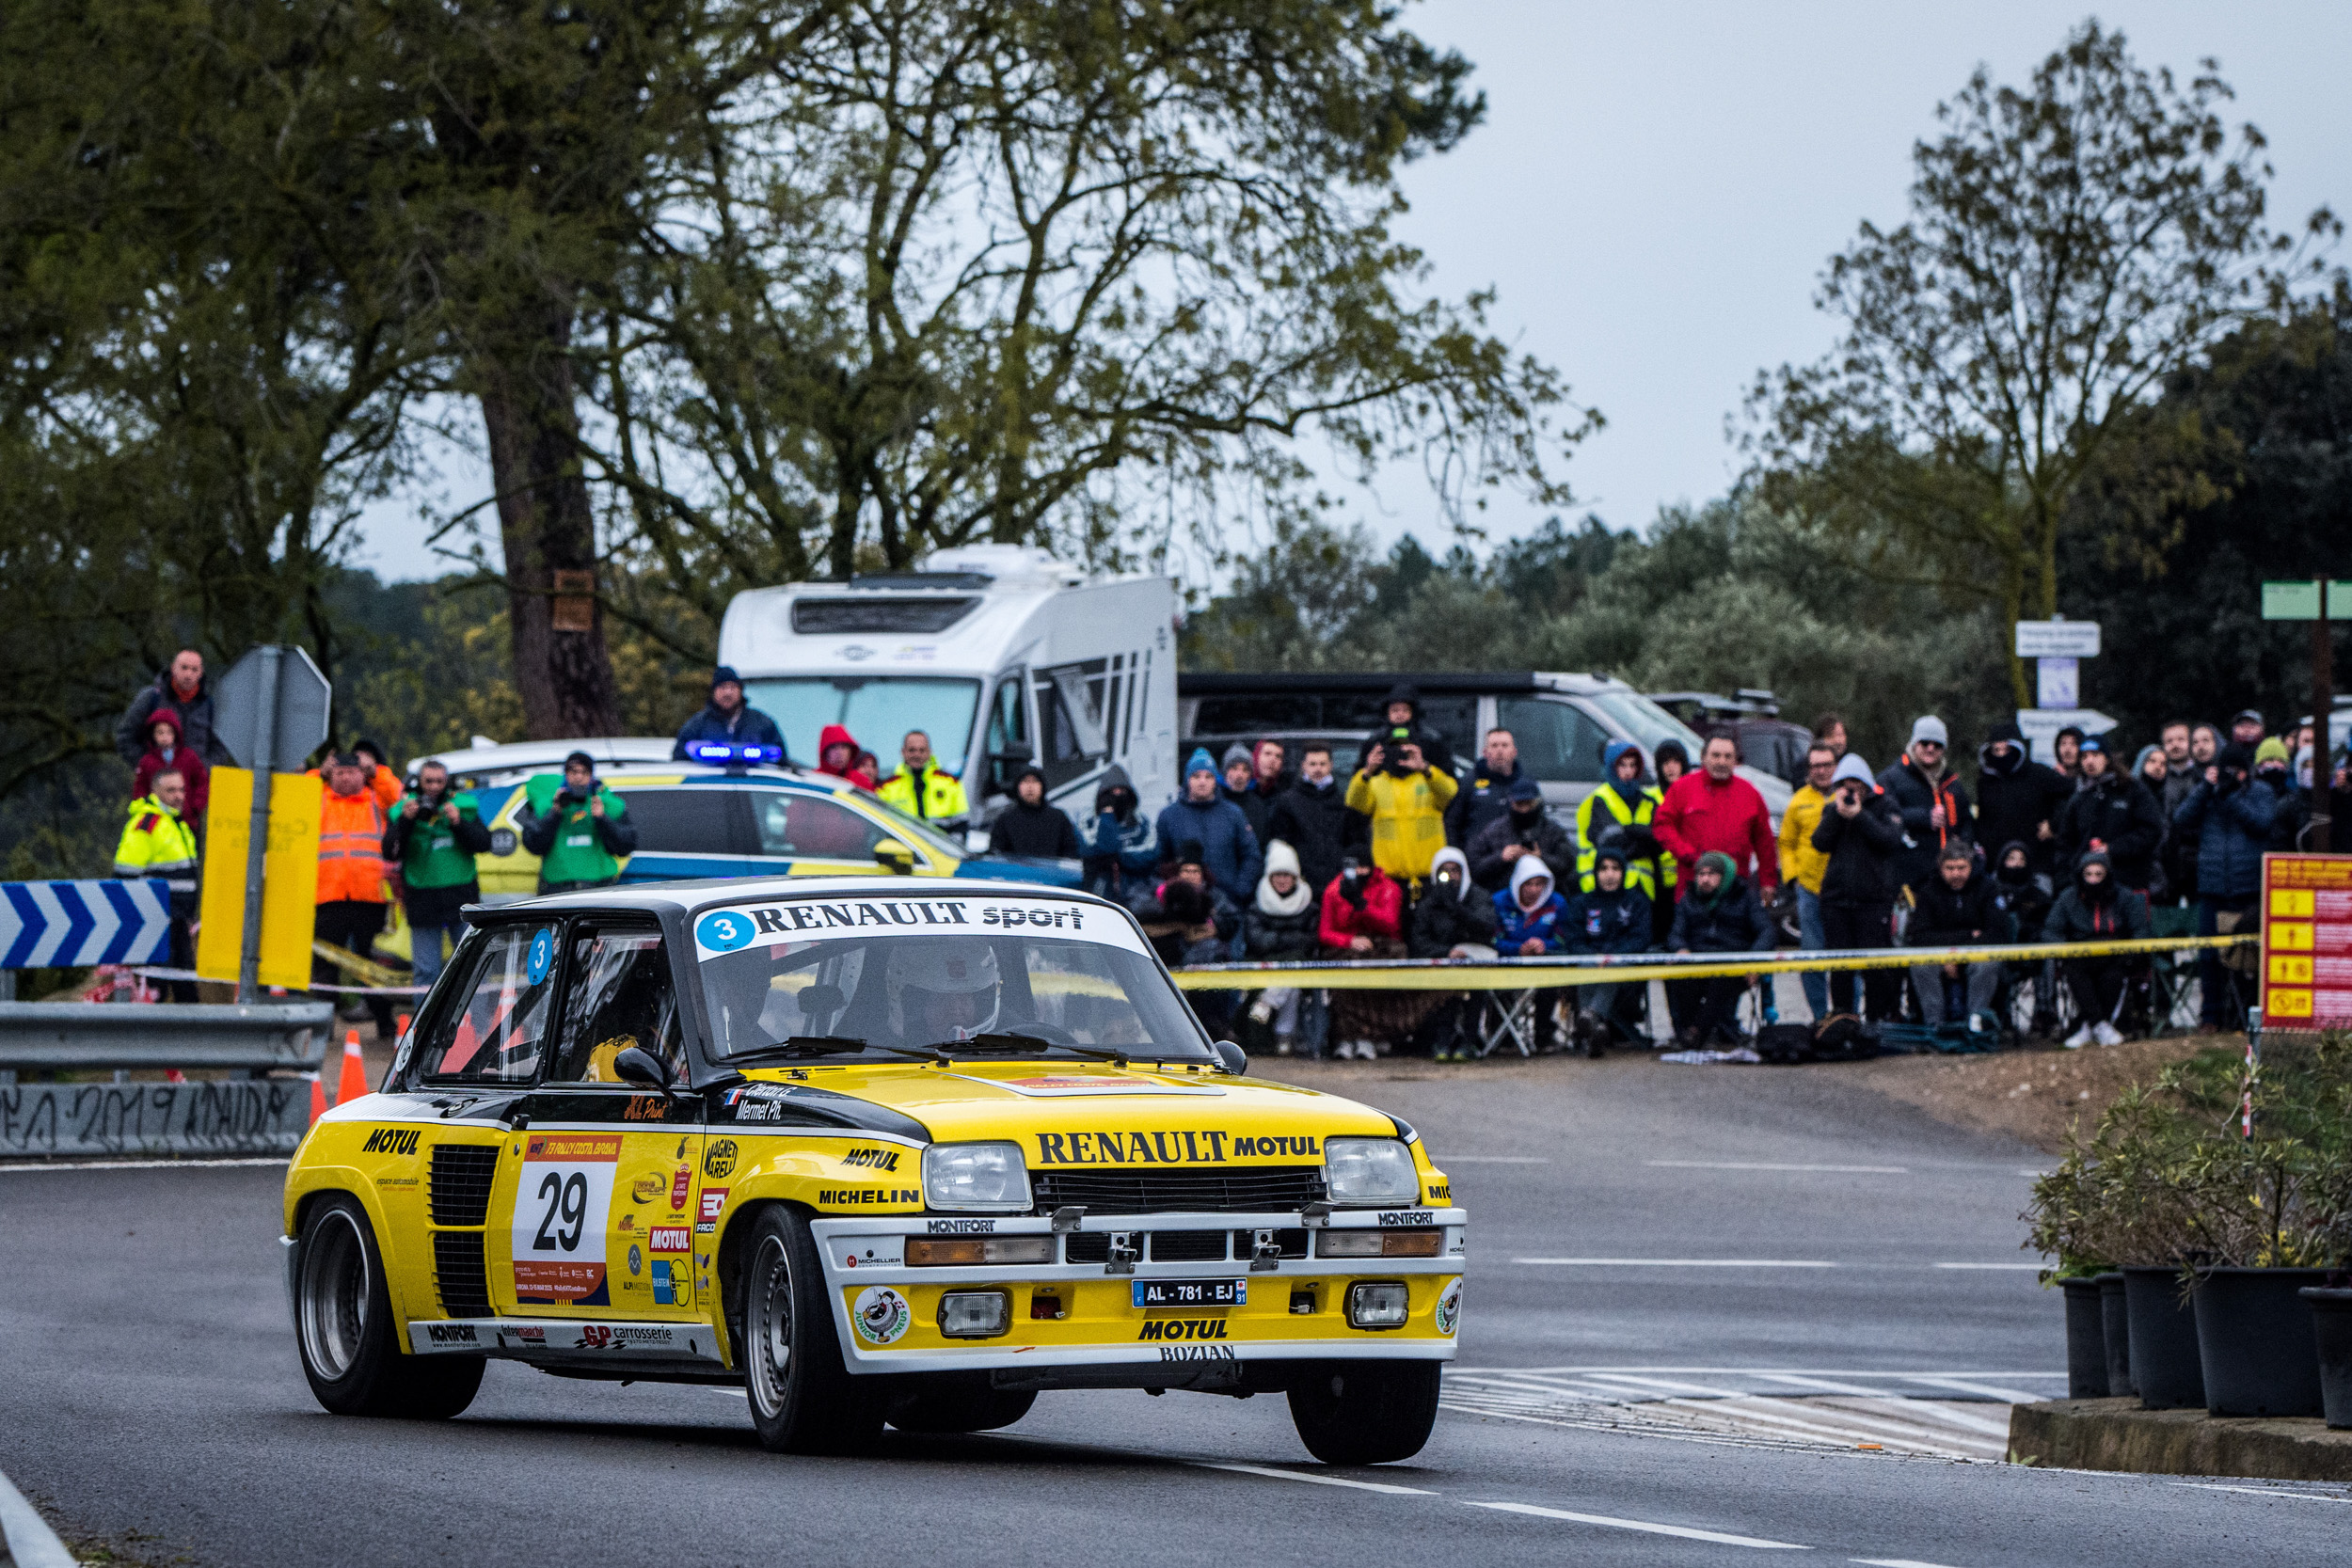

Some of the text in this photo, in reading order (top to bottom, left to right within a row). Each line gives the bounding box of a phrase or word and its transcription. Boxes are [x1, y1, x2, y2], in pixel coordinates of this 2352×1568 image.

[749, 902, 1084, 934] RENAULT sport
[714, 918, 738, 941] 3
[534, 939, 546, 970] 3
[735, 1100, 771, 1120] Mermet
[362, 1128, 421, 1156] MOTUL
[1035, 1131, 1321, 1164] RENAULT MOTUL
[840, 1148, 900, 1172] MOTUL
[818, 1189, 920, 1204] MICHELIN
[532, 1171, 588, 1252] 29
[1377, 1212, 1434, 1226] MONTFORT
[928, 1219, 995, 1233] MONTFORT
[650, 1229, 689, 1249] MOTUL
[1236, 1292, 1246, 1303] 91
[427, 1323, 478, 1342] MONTFORT
[583, 1324, 673, 1346] GP carrosserie
[855, 1310, 908, 1341] JUNIOR PNEUS
[1137, 1319, 1229, 1340] MOTUL
[1158, 1345, 1235, 1361] BOZIAN
